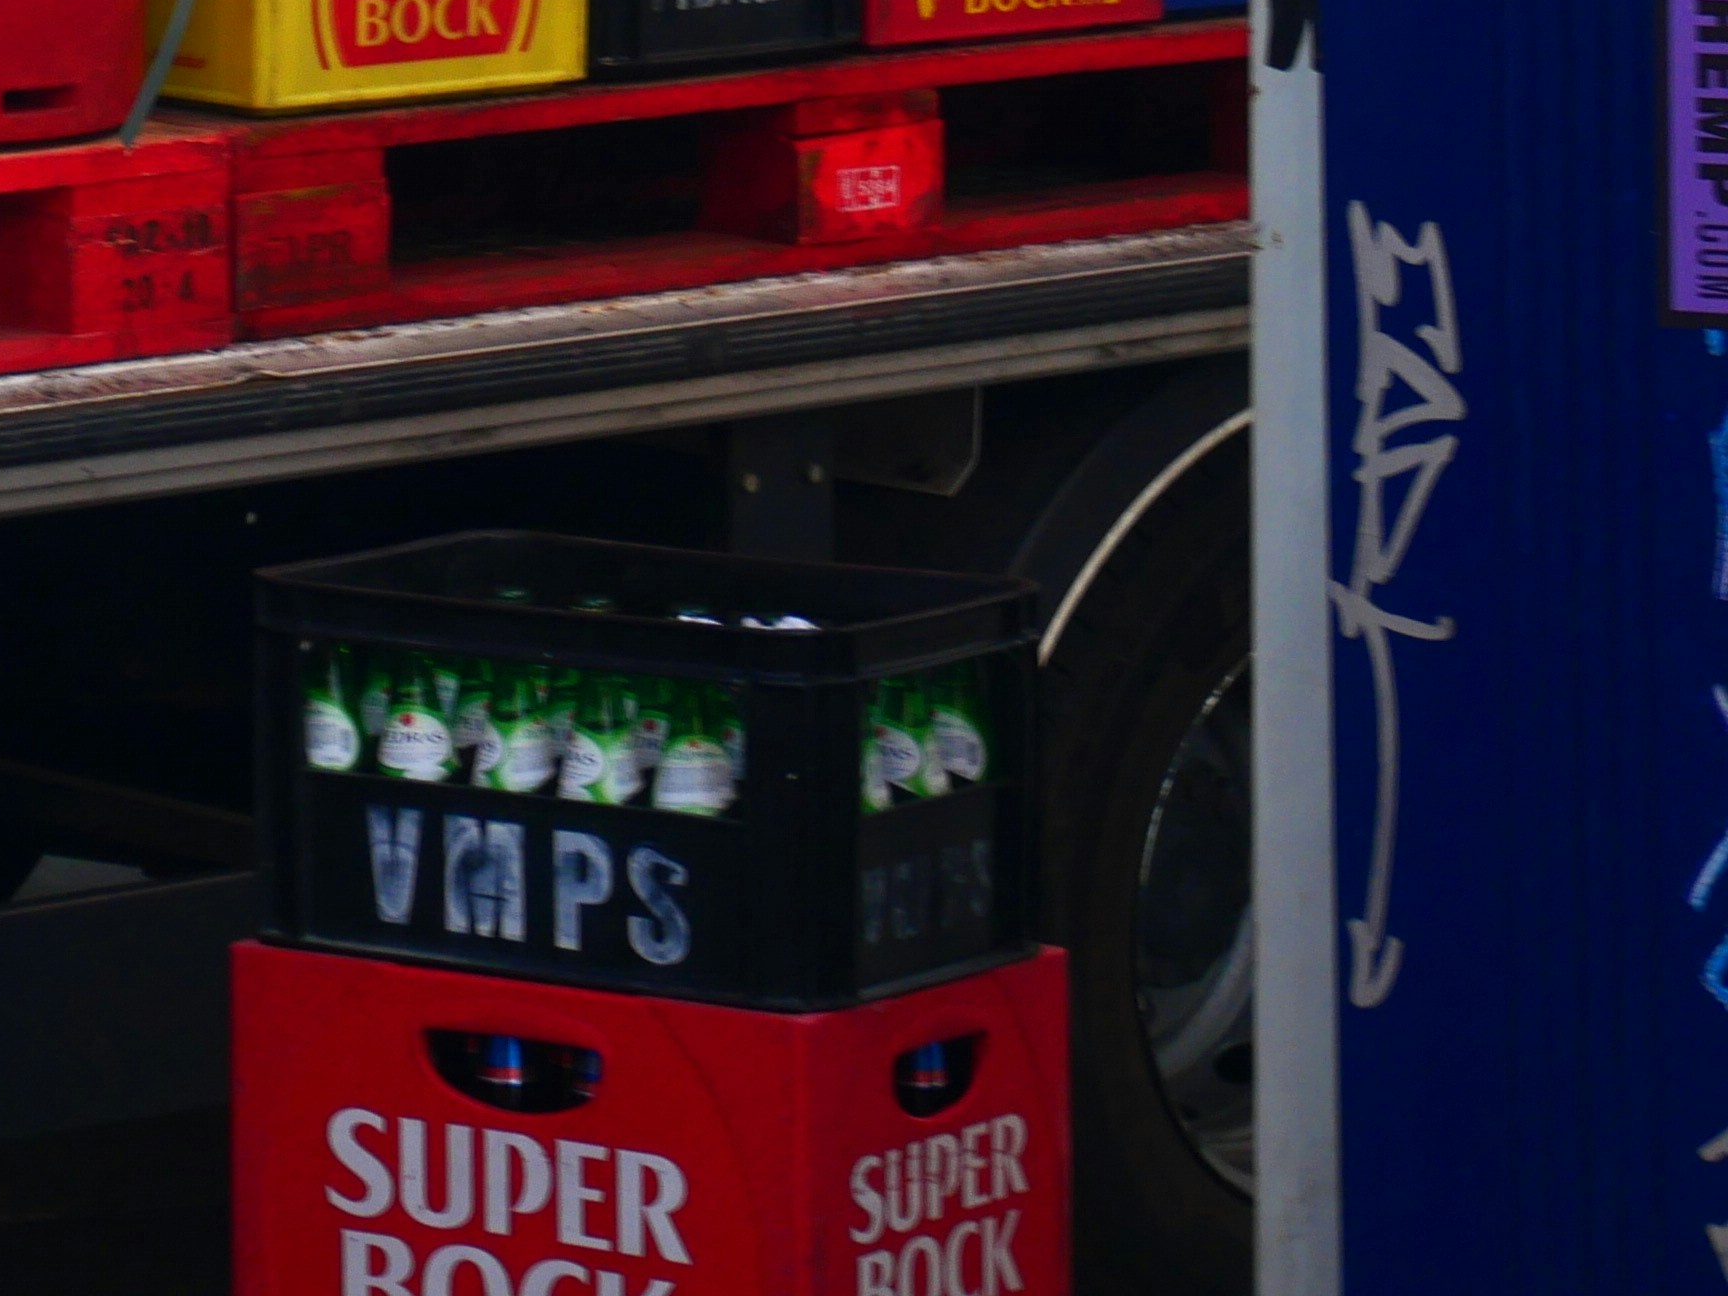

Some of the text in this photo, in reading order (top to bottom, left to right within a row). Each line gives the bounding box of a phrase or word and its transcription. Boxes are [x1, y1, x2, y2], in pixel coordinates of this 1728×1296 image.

[366, 806, 693, 967] VMPS
[323, 1107, 694, 1266] SUPER
[848, 1113, 1031, 1245] SUPER
